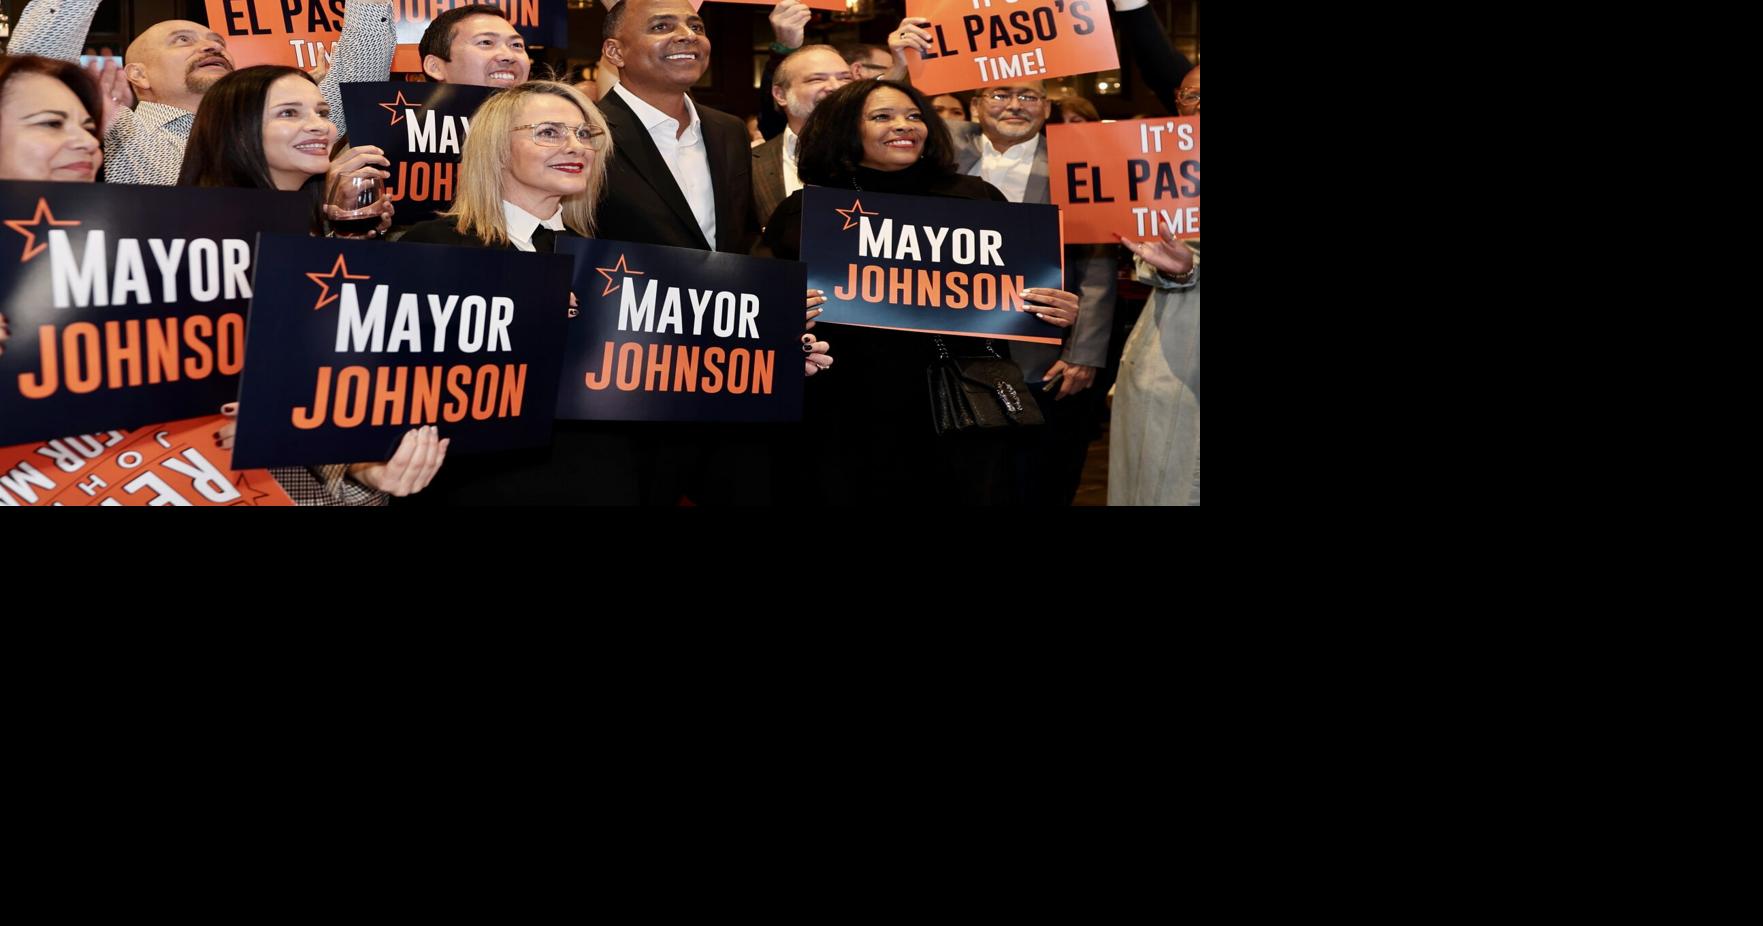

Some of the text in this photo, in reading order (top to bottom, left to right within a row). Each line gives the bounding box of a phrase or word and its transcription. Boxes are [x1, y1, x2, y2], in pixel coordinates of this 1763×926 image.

[223, 0, 272, 36] EL
[963, 1, 1096, 52] PASO'S
[974, 48, 1047, 82] TIME!
[1140, 121, 1194, 153] IT'S
[386, 161, 463, 202] JOH
[1066, 162, 1115, 204] EL
[859, 216, 1005, 266] MAYOR
[48, 229, 253, 308] MAYOR
[834, 264, 1025, 312] JOHNSON
[334, 283, 514, 353] MAYOR
[618, 276, 760, 339] MAYOR
[18, 313, 245, 399] JOHNSO
[585, 341, 775, 395] JOHNSON
[291, 364, 528, 430] JOHNSON
[101, 447, 241, 506] RE
